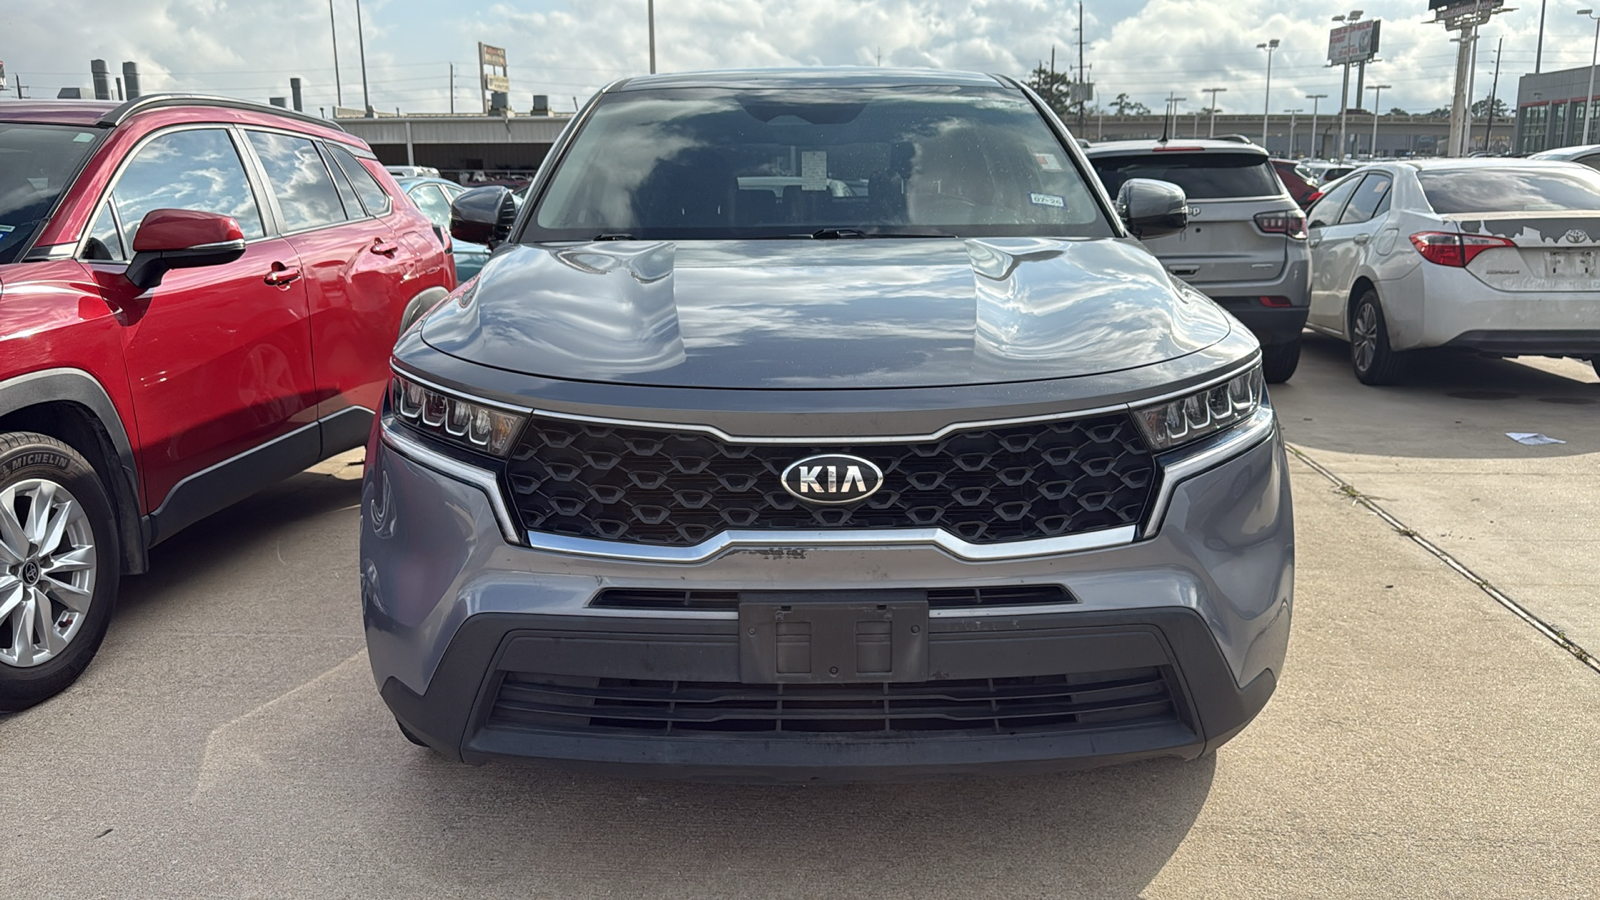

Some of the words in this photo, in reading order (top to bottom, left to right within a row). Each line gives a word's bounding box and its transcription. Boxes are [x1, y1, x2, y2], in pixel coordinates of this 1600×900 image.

[1033, 196, 1062, 205] 07-26
[12, 454, 67, 470] MICHELIN
[799, 465, 867, 493] KIA
